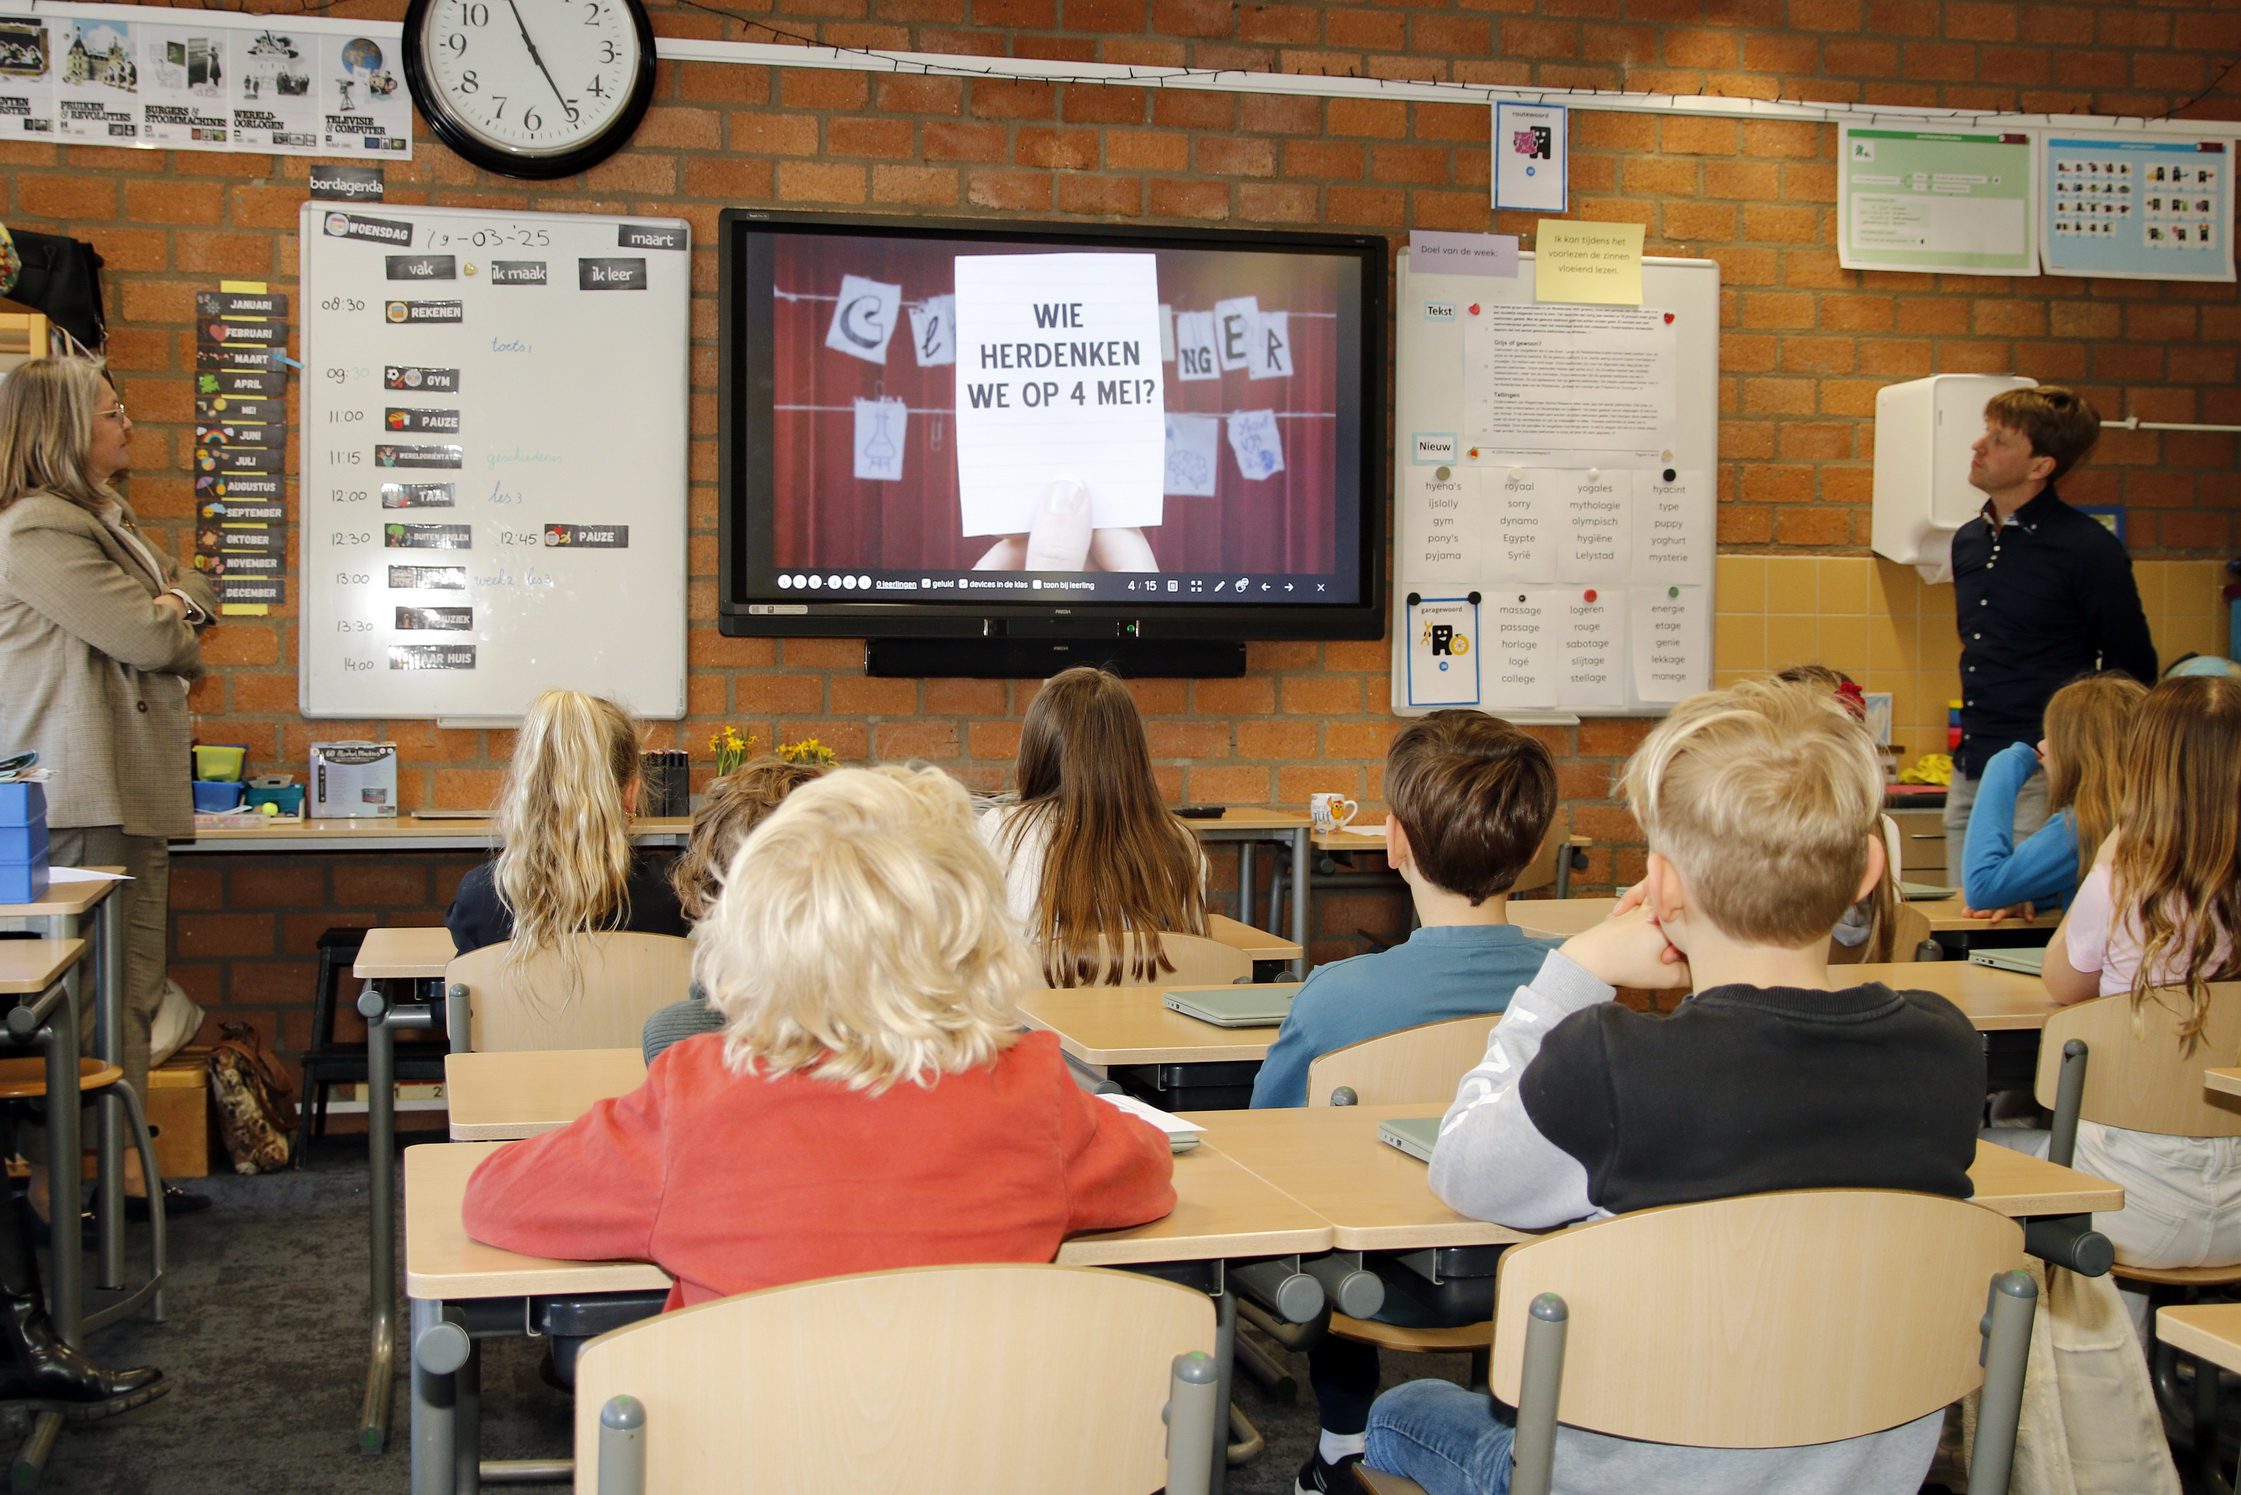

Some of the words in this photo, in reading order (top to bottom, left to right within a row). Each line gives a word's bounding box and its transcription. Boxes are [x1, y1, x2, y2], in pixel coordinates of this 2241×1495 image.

[460, 3, 488, 27] 10
[584, 3, 600, 26] 2
[449, 33, 466, 59] 9
[600, 40, 615, 63] 3
[461, 70, 478, 93] 8
[586, 74, 603, 97] 4
[145, 105, 189, 115] BURGERS
[492, 96, 507, 119] 7
[564, 99, 580, 123] 5
[325, 115, 374, 126] TELEVISIE
[524, 105, 542, 131] 6
[234, 119, 284, 130] OORLOGEN
[335, 126, 386, 135] COMPUTER
[310, 177, 383, 194] bordagenda
[350, 222, 408, 241] WOENSDAG
[631, 233, 674, 247] maart
[1554, 235, 1562, 243] Ik
[1564, 235, 1580, 243] kan
[1582, 236, 1610, 246] tijdens
[1612, 238, 1626, 246] het
[1421, 245, 1440, 254] Doel
[1548, 250, 1588, 259] voorlezen
[1590, 251, 1600, 259] de
[1603, 252, 1630, 260] zinnen
[409, 262, 434, 276] vak
[493, 268, 505, 279] ik
[508, 267, 545, 280] maak
[592, 266, 605, 280] ik
[608, 267, 632, 282] leer
[230, 300, 272, 310] JANUARI
[321, 297, 365, 311] 08:30
[411, 307, 461, 318] REKENEN
[1033, 303, 1084, 329] WIE
[1428, 306, 1453, 316] Tekst
[225, 327, 272, 339] FEBRUARI
[234, 354, 269, 365] MAART
[980, 341, 1140, 369] HERDENKEN
[234, 379, 262, 389] APRIL
[427, 376, 450, 387] GYM
[967, 383, 1010, 409] WE
[1022, 382, 1059, 407] OP
[1070, 381, 1086, 406] 4
[1097, 379, 1155, 405] MEI?
[241, 405, 257, 415] MEI
[422, 416, 458, 428] PAUZE
[239, 431, 262, 440] JUNI
[1419, 442, 1451, 451] Nieuw
[235, 457, 256, 466] JULI
[227, 482, 276, 492] AUGUSTUS
[1504, 482, 1535, 492] royaal
[1577, 485, 1613, 494] yogales
[1653, 485, 1686, 494] hyacint
[332, 490, 367, 502] 12:00
[419, 490, 449, 502] TAAL
[1428, 498, 1458, 509] ijslolly
[1508, 501, 1531, 510] sorry
[1569, 502, 1621, 511] mythologie
[1659, 503, 1680, 512] type
[226, 508, 282, 518] SEPTEMBER
[1433, 518, 1454, 527] gym
[1500, 517, 1539, 526] dynamo
[1572, 517, 1618, 527] olympisch
[1655, 519, 1684, 529] puppy
[226, 535, 270, 545] OKTOBER
[332, 532, 370, 546] 12:30
[501, 532, 537, 545] 12:45
[579, 531, 615, 543] PAUZE
[1428, 535, 1459, 544] pony's
[1503, 534, 1536, 544] Egypte
[1651, 536, 1686, 546] yoghurt
[1425, 551, 1461, 561] pyjama
[1508, 551, 1531, 560] Syrië
[1576, 551, 1614, 561] Lelystad
[1650, 553, 1688, 563] mysterie
[226, 559, 278, 569] NOVEMBER
[882, 580, 917, 590] leerlingen
[932, 580, 954, 589] geluid
[969, 580, 996, 588] devices
[997, 581, 1003, 589] in
[1004, 581, 1014, 589] de
[1016, 581, 1028, 589] klas
[1060, 581, 1069, 590] bij
[1069, 582, 1095, 591] leerling
[1127, 581, 1136, 591] 4
[1145, 581, 1157, 592] 15
[226, 587, 277, 598] DECEMBER
[1500, 606, 1542, 616] massage
[1570, 605, 1604, 616] logeren
[1652, 604, 1686, 614] energie
[1501, 623, 1540, 632] passage
[1574, 624, 1601, 632] rouge
[1655, 621, 1682, 630] etage
[1502, 639, 1538, 650] horloge
[1566, 639, 1609, 649] sabotage
[1656, 638, 1681, 648] genie
[447, 653, 472, 664] HUIS
[1509, 656, 1530, 667] logé
[1571, 656, 1605, 666] slijtage
[1652, 655, 1686, 664] lekkage
[1502, 673, 1536, 684] college
[1571, 673, 1607, 683] stellage
[1652, 672, 1687, 681] manege
[433, 1086, 442, 1097] 2
